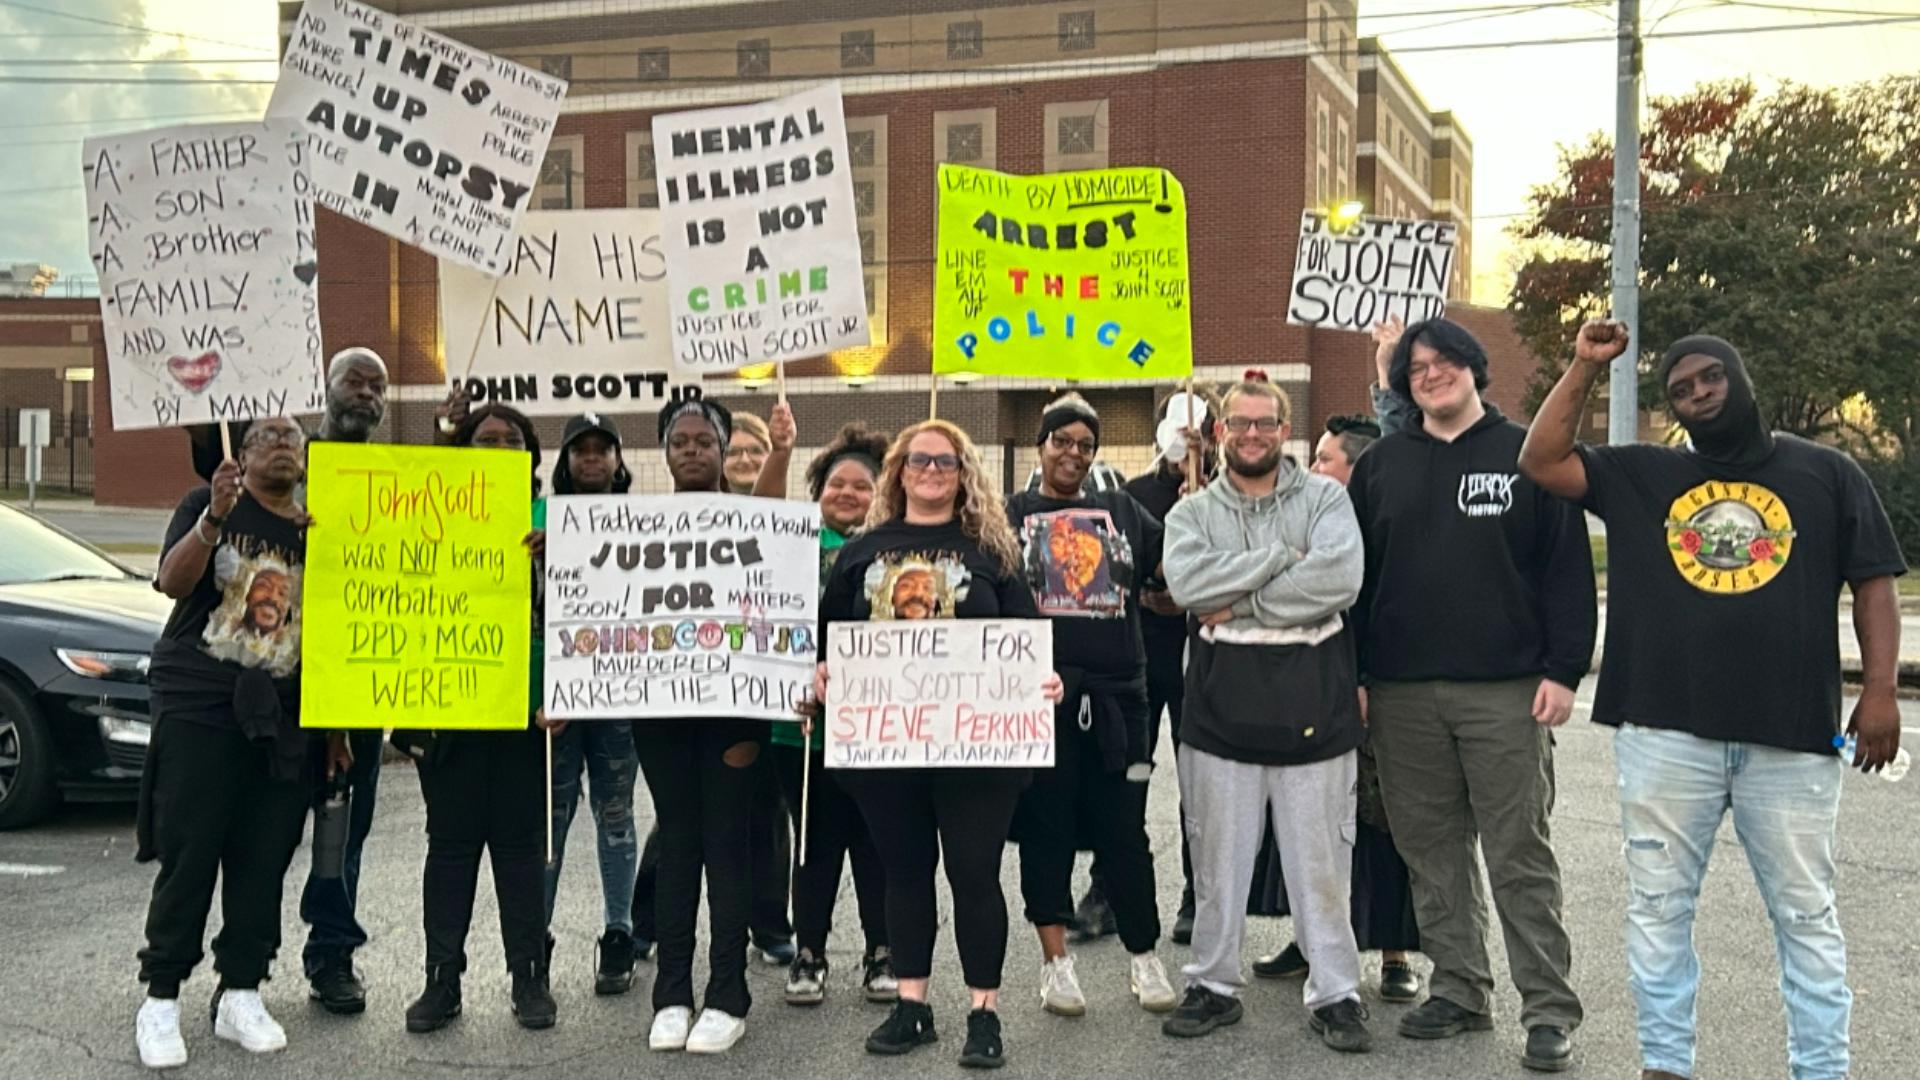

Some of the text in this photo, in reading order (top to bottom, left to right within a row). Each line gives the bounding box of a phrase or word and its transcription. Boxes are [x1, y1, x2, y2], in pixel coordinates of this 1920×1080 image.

[301, 12, 326, 35] NO
[299, 35, 344, 64] MORE
[349, 29, 490, 105] TIMES
[372, 83, 427, 123] UP
[490, 101, 552, 134] ARREST
[482, 132, 534, 166] POLICE
[503, 124, 532, 144] THE
[671, 107, 825, 158] MENTAL
[151, 134, 267, 177] FATHER
[307, 100, 530, 210] AUTOPSY
[665, 147, 835, 202] ILLNESS
[154, 175, 224, 221] SON
[352, 171, 399, 215] IN
[945, 168, 1010, 198] DEATH
[1026, 183, 1056, 210] BY
[147, 223, 263, 260] Brother
[452, 211, 482, 237] NOT
[686, 196, 827, 248] IS NOT
[973, 209, 1136, 250] ARREST
[593, 232, 668, 283] HIS
[745, 245, 769, 273] A
[945, 248, 986, 269] LINE
[1110, 248, 1179, 269] JUSTICE
[1297, 235, 1450, 291] FOR JOHN
[687, 265, 828, 312] CRIME
[956, 270, 986, 289] EM
[1008, 268, 1100, 300] THE
[495, 294, 645, 347] NAME
[677, 298, 824, 336] JUSTICE FOR
[1291, 275, 1418, 328] SCOTT
[122, 323, 245, 358] AND WAS
[681, 335, 749, 364] JOHN
[763, 316, 834, 356] SCOTT
[956, 309, 1155, 368] POLICE
[551, 372, 668, 400] SCOTT
[153, 388, 287, 425] BY MANY
[562, 504, 580, 534] A
[676, 511, 691, 531] a
[751, 512, 766, 528] a
[343, 539, 505, 584] was NOT being
[590, 537, 763, 571] JUSTICE
[642, 582, 714, 614] FOR
[746, 569, 773, 588] HE
[727, 588, 806, 610] MATTERS
[347, 621, 408, 656] DPD
[838, 624, 1036, 664] JUSTICE FOR
[372, 665, 478, 709] WERE!!!
[552, 675, 649, 712] ARREST
[662, 675, 717, 704] THE
[832, 667, 893, 704] JOHN
[902, 661, 986, 702] SCOTT
[832, 703, 1051, 743] STEVE PERKINS
